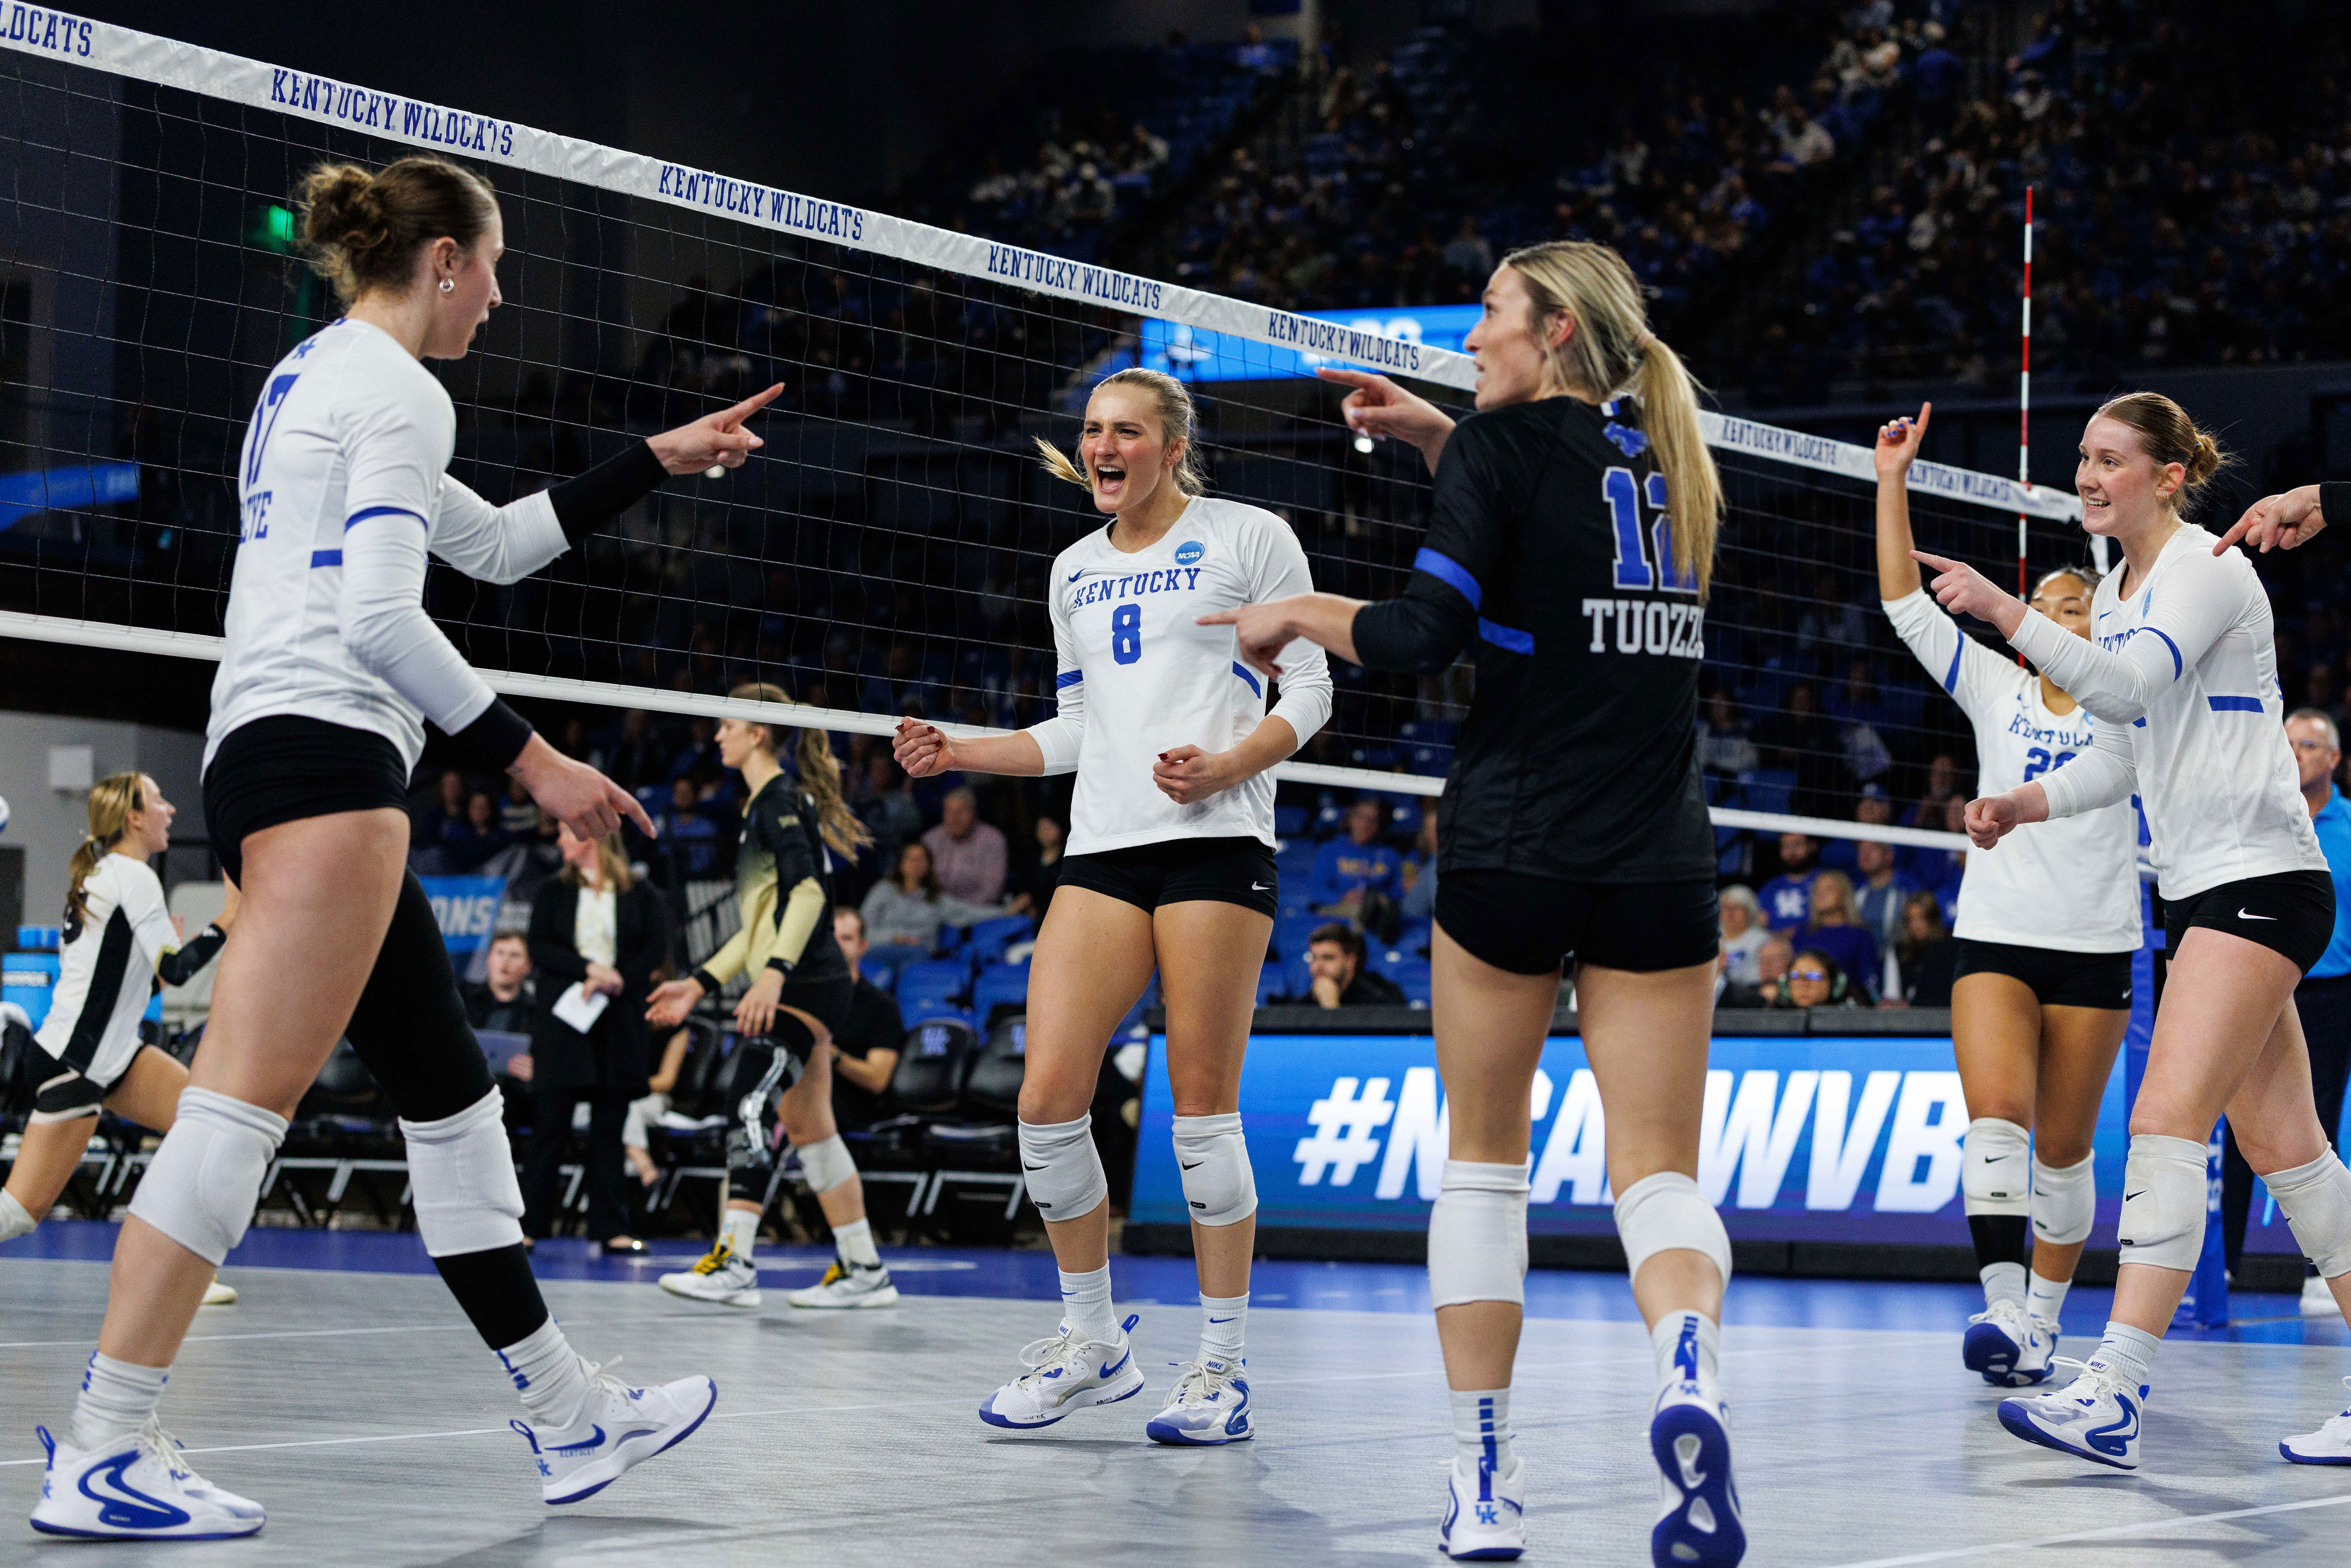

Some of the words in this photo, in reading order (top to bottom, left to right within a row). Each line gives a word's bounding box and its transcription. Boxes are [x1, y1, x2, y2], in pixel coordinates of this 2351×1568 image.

[271, 68, 397, 130] KENTUCKY
[404, 101, 513, 155] WILDCATS
[659, 165, 765, 217] KENTUCKY
[770, 191, 863, 241] WILDCATS
[987, 244, 1078, 290] KENTUCKY
[1082, 266, 1161, 310] WILDCATS
[1268, 312, 1347, 353] KENTUCKY
[1349, 330, 1419, 370] WILDCATS
[1177, 551, 1200, 560] NCAA
[1073, 567, 1201, 609] KENTUCKY
[1112, 603, 1142, 665] 8
[1207, 1360, 1224, 1370] NIKE
[2088, 1360, 2107, 1370] NIKE
